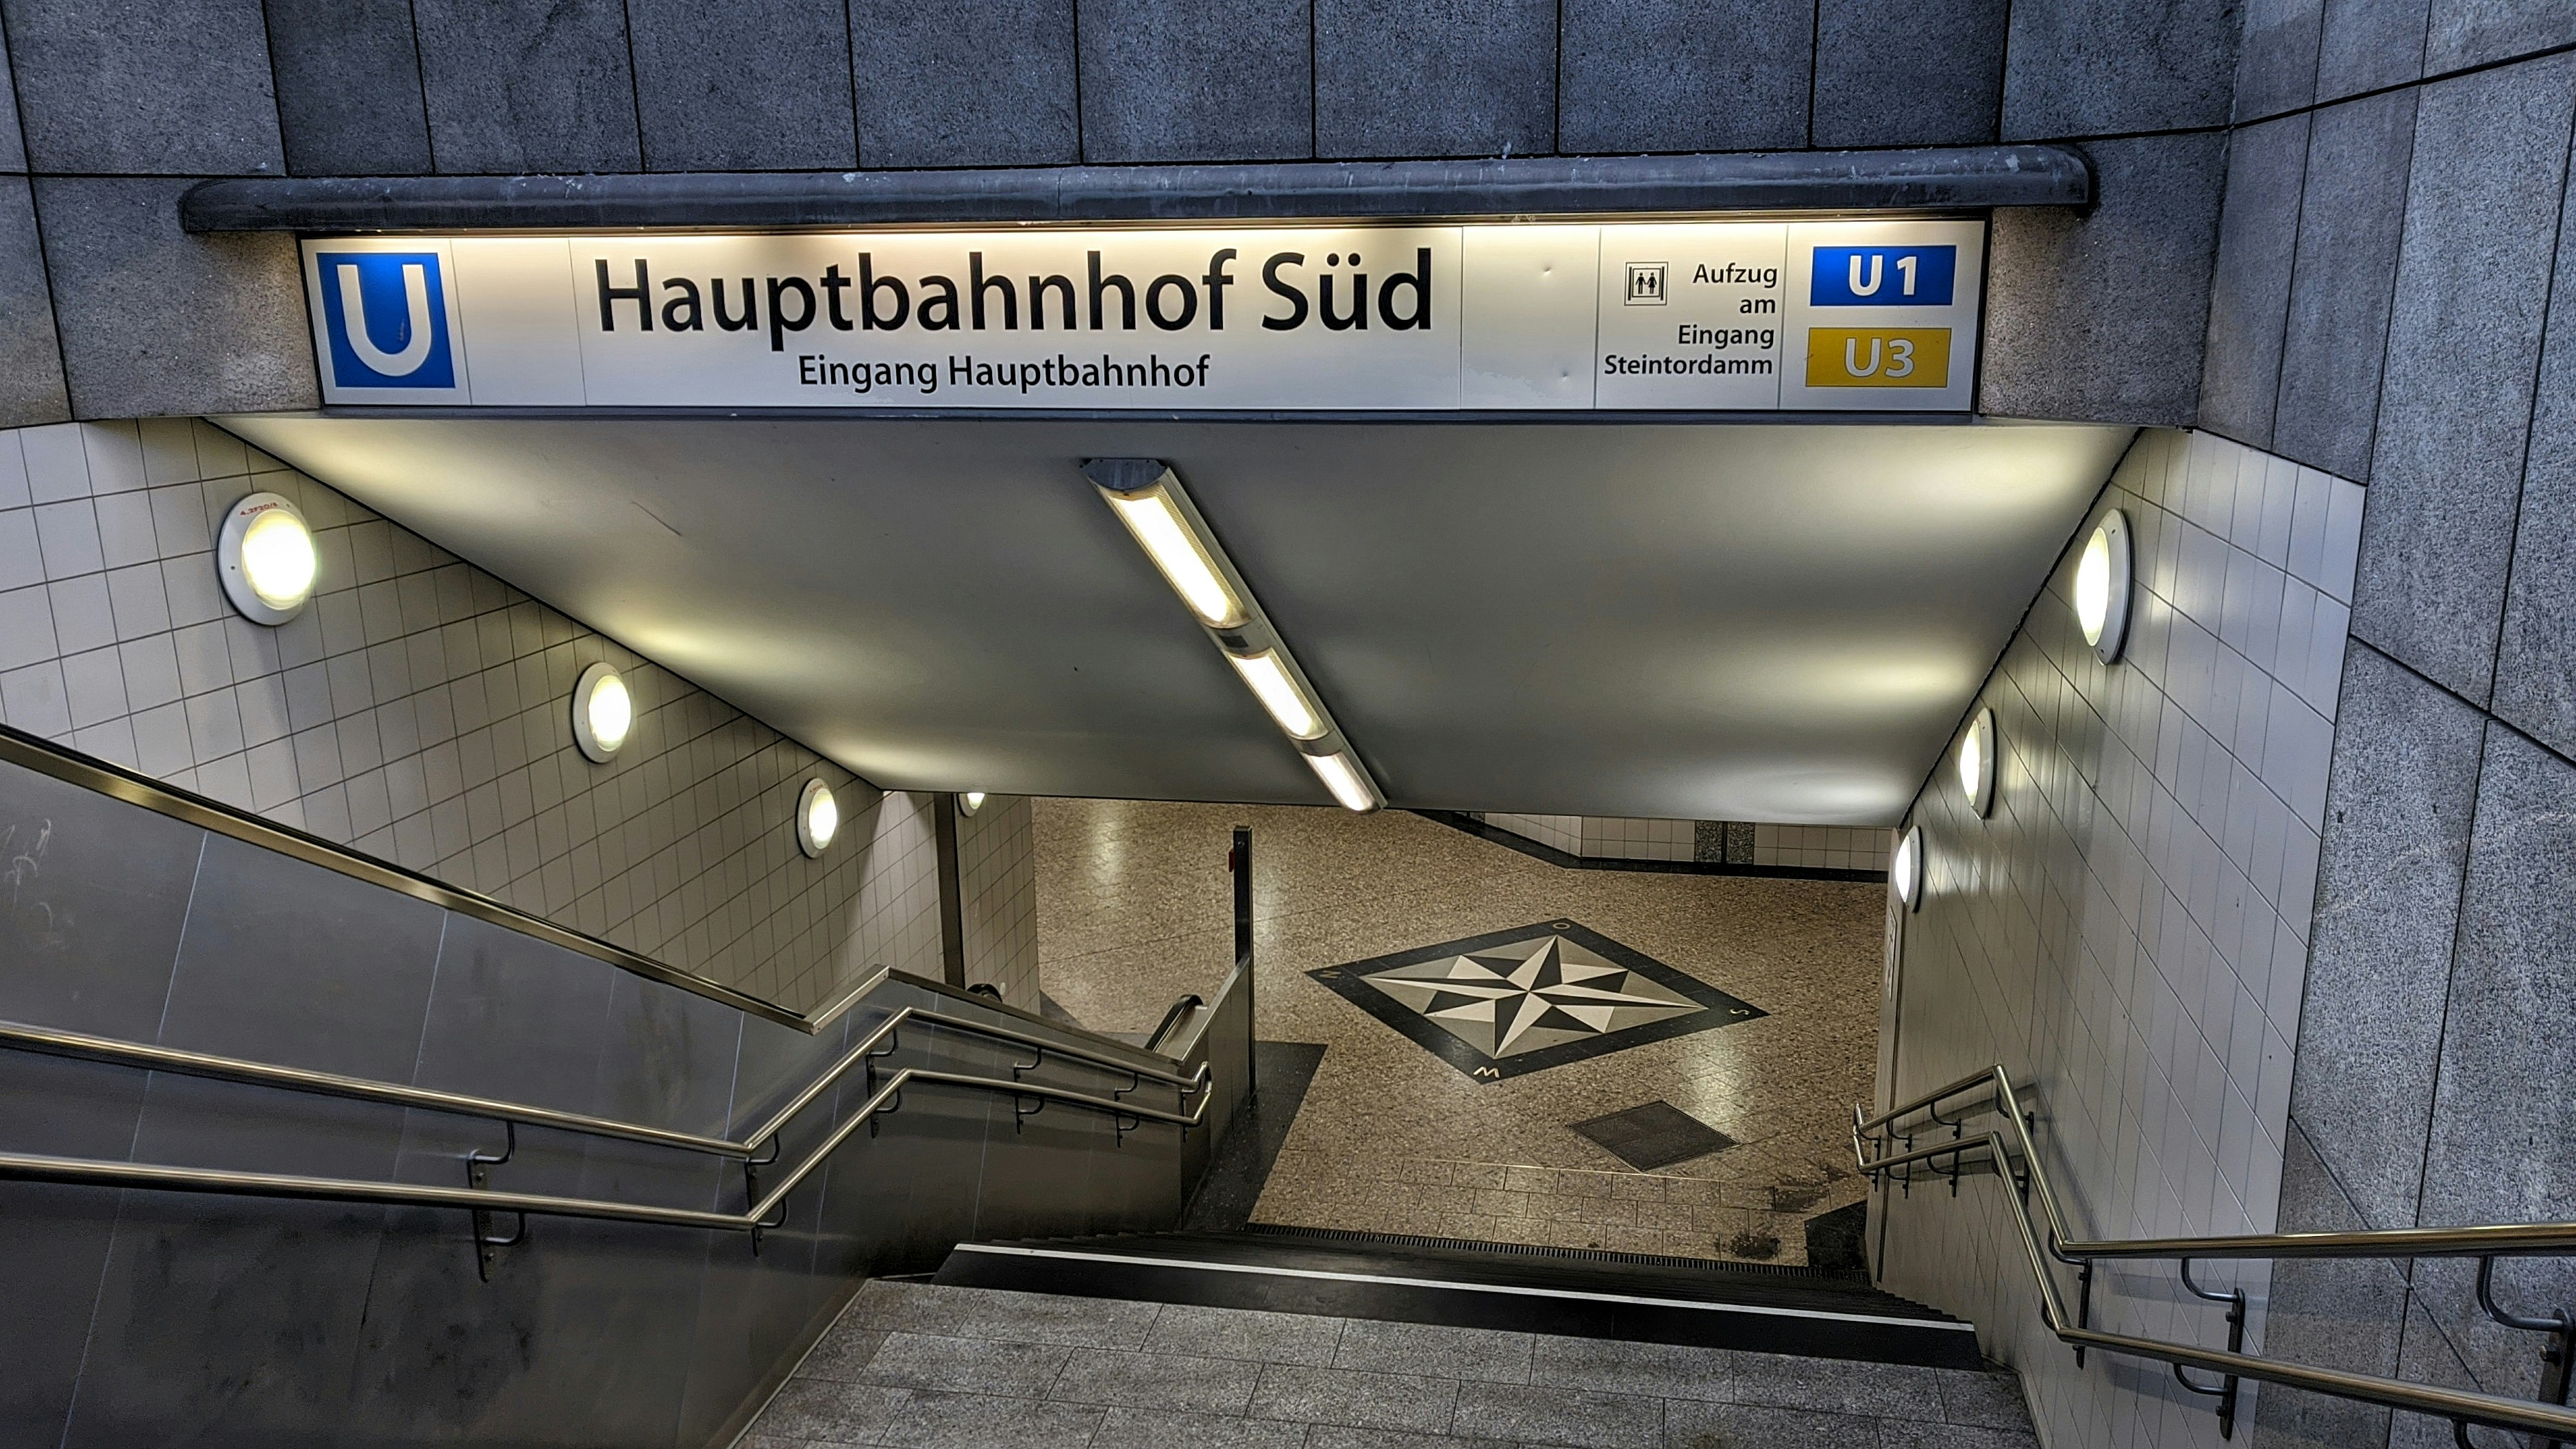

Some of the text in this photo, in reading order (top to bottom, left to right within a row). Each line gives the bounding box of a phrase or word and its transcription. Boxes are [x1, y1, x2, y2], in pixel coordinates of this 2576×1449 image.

[1692, 262, 1778, 288] Aufzug
[595, 247, 1431, 352] Hauptbahnhof Süd
[1739, 298, 1776, 314] am
[336, 264, 432, 377] U
[1678, 324, 1775, 350] Eingang
[1604, 354, 1773, 375] Steintordamm
[1844, 337, 1916, 378] U3
[799, 354, 1211, 395] Eingang Hauptbahnhof
